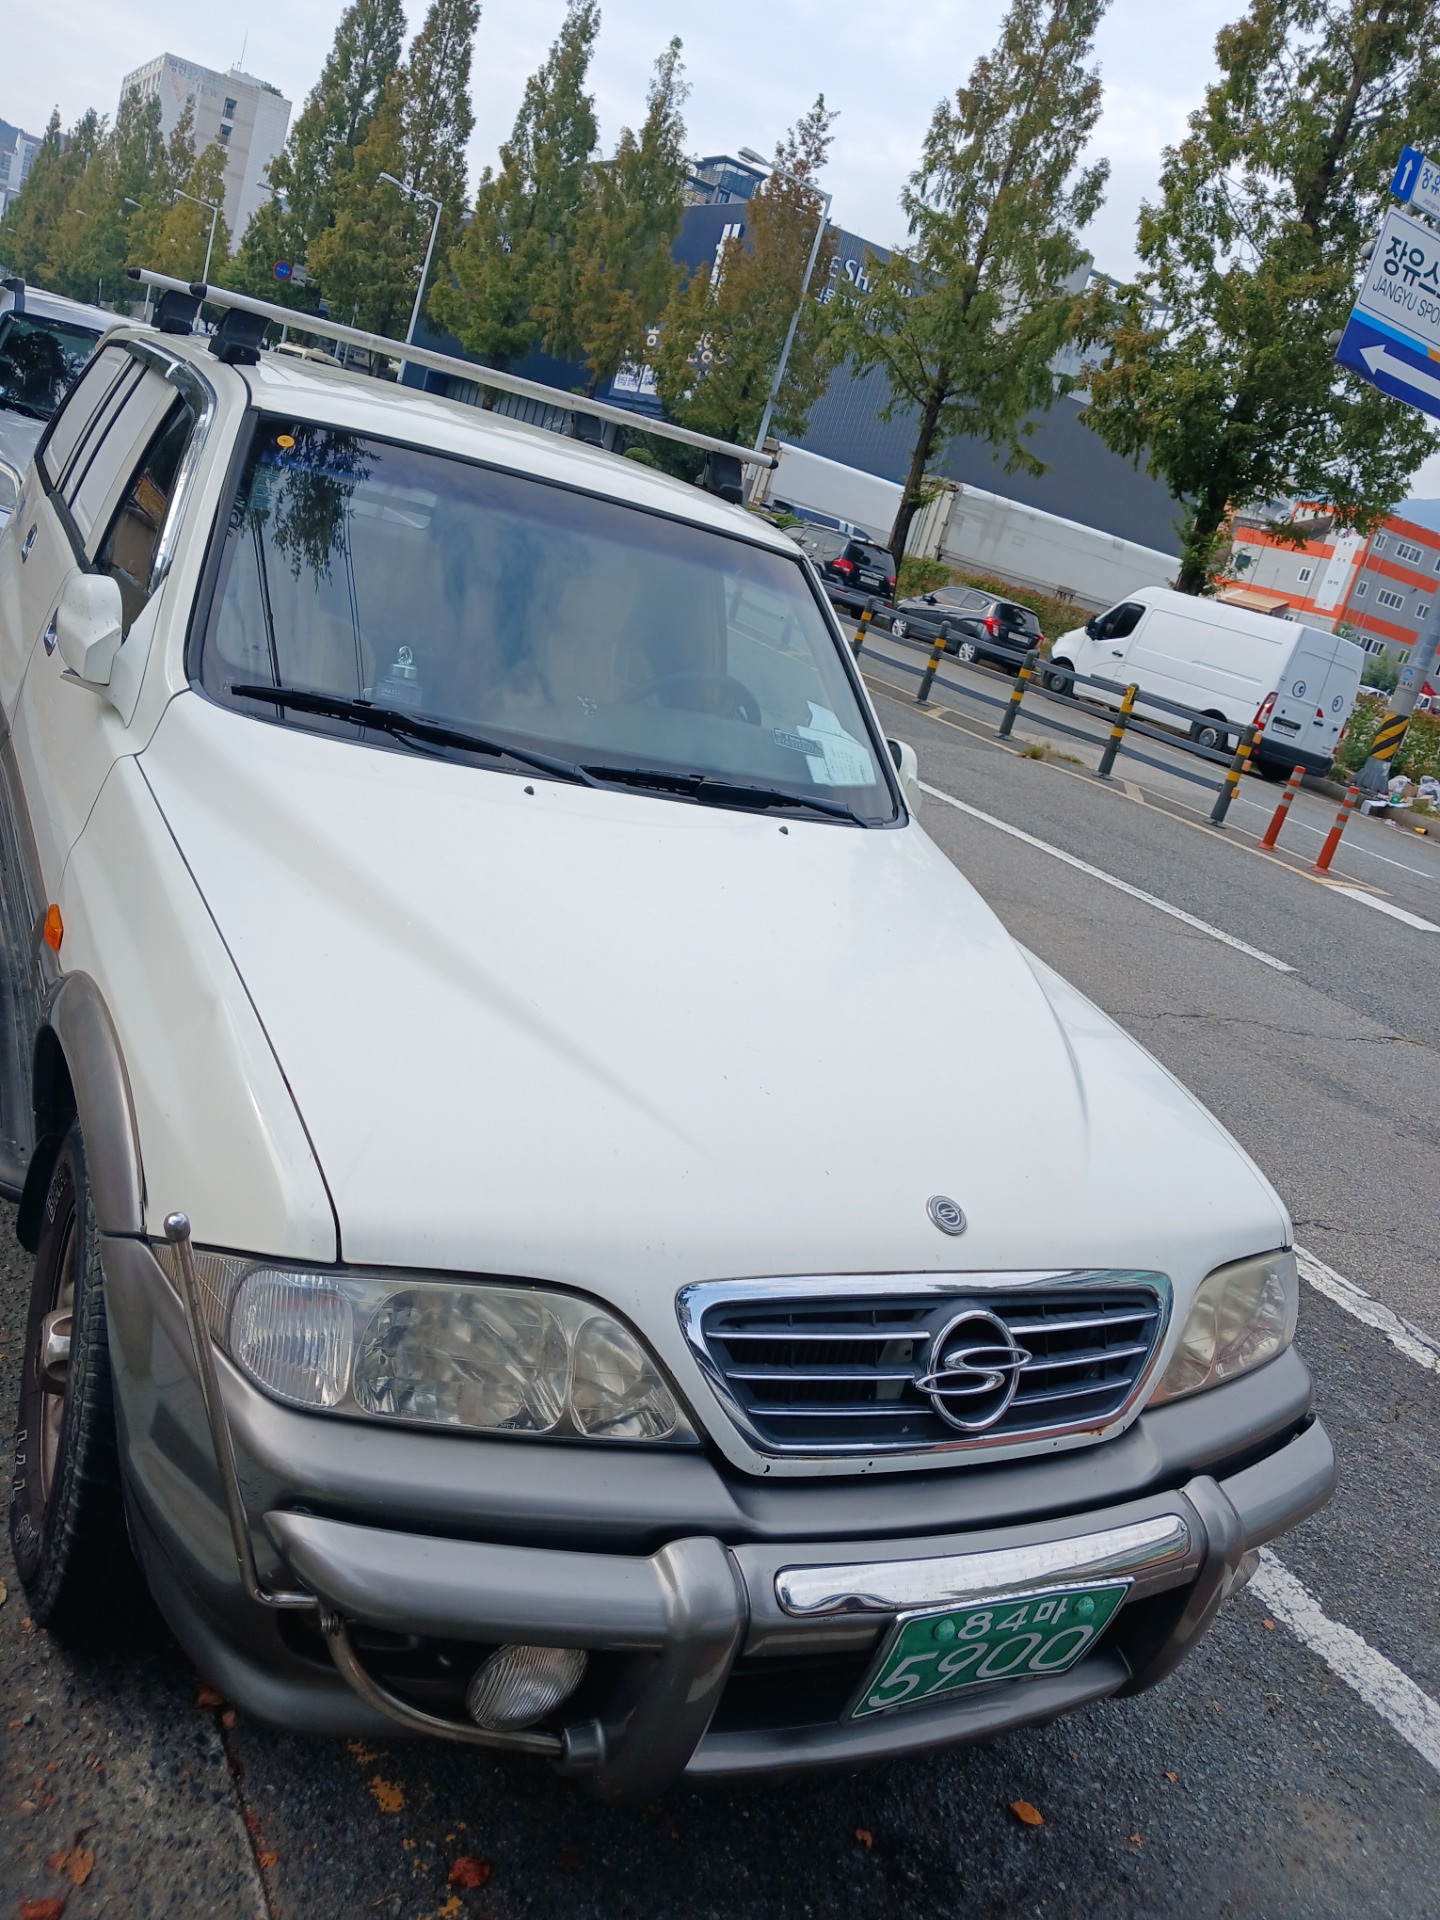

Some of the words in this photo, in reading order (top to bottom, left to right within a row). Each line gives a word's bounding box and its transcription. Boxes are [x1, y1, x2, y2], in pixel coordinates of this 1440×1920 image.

[1372, 275, 1418, 311] JANGYU
[1383, 235, 1440, 299] 장유스
[957, 1597, 1068, 1640] 84마
[868, 1624, 1094, 1707] 5900
